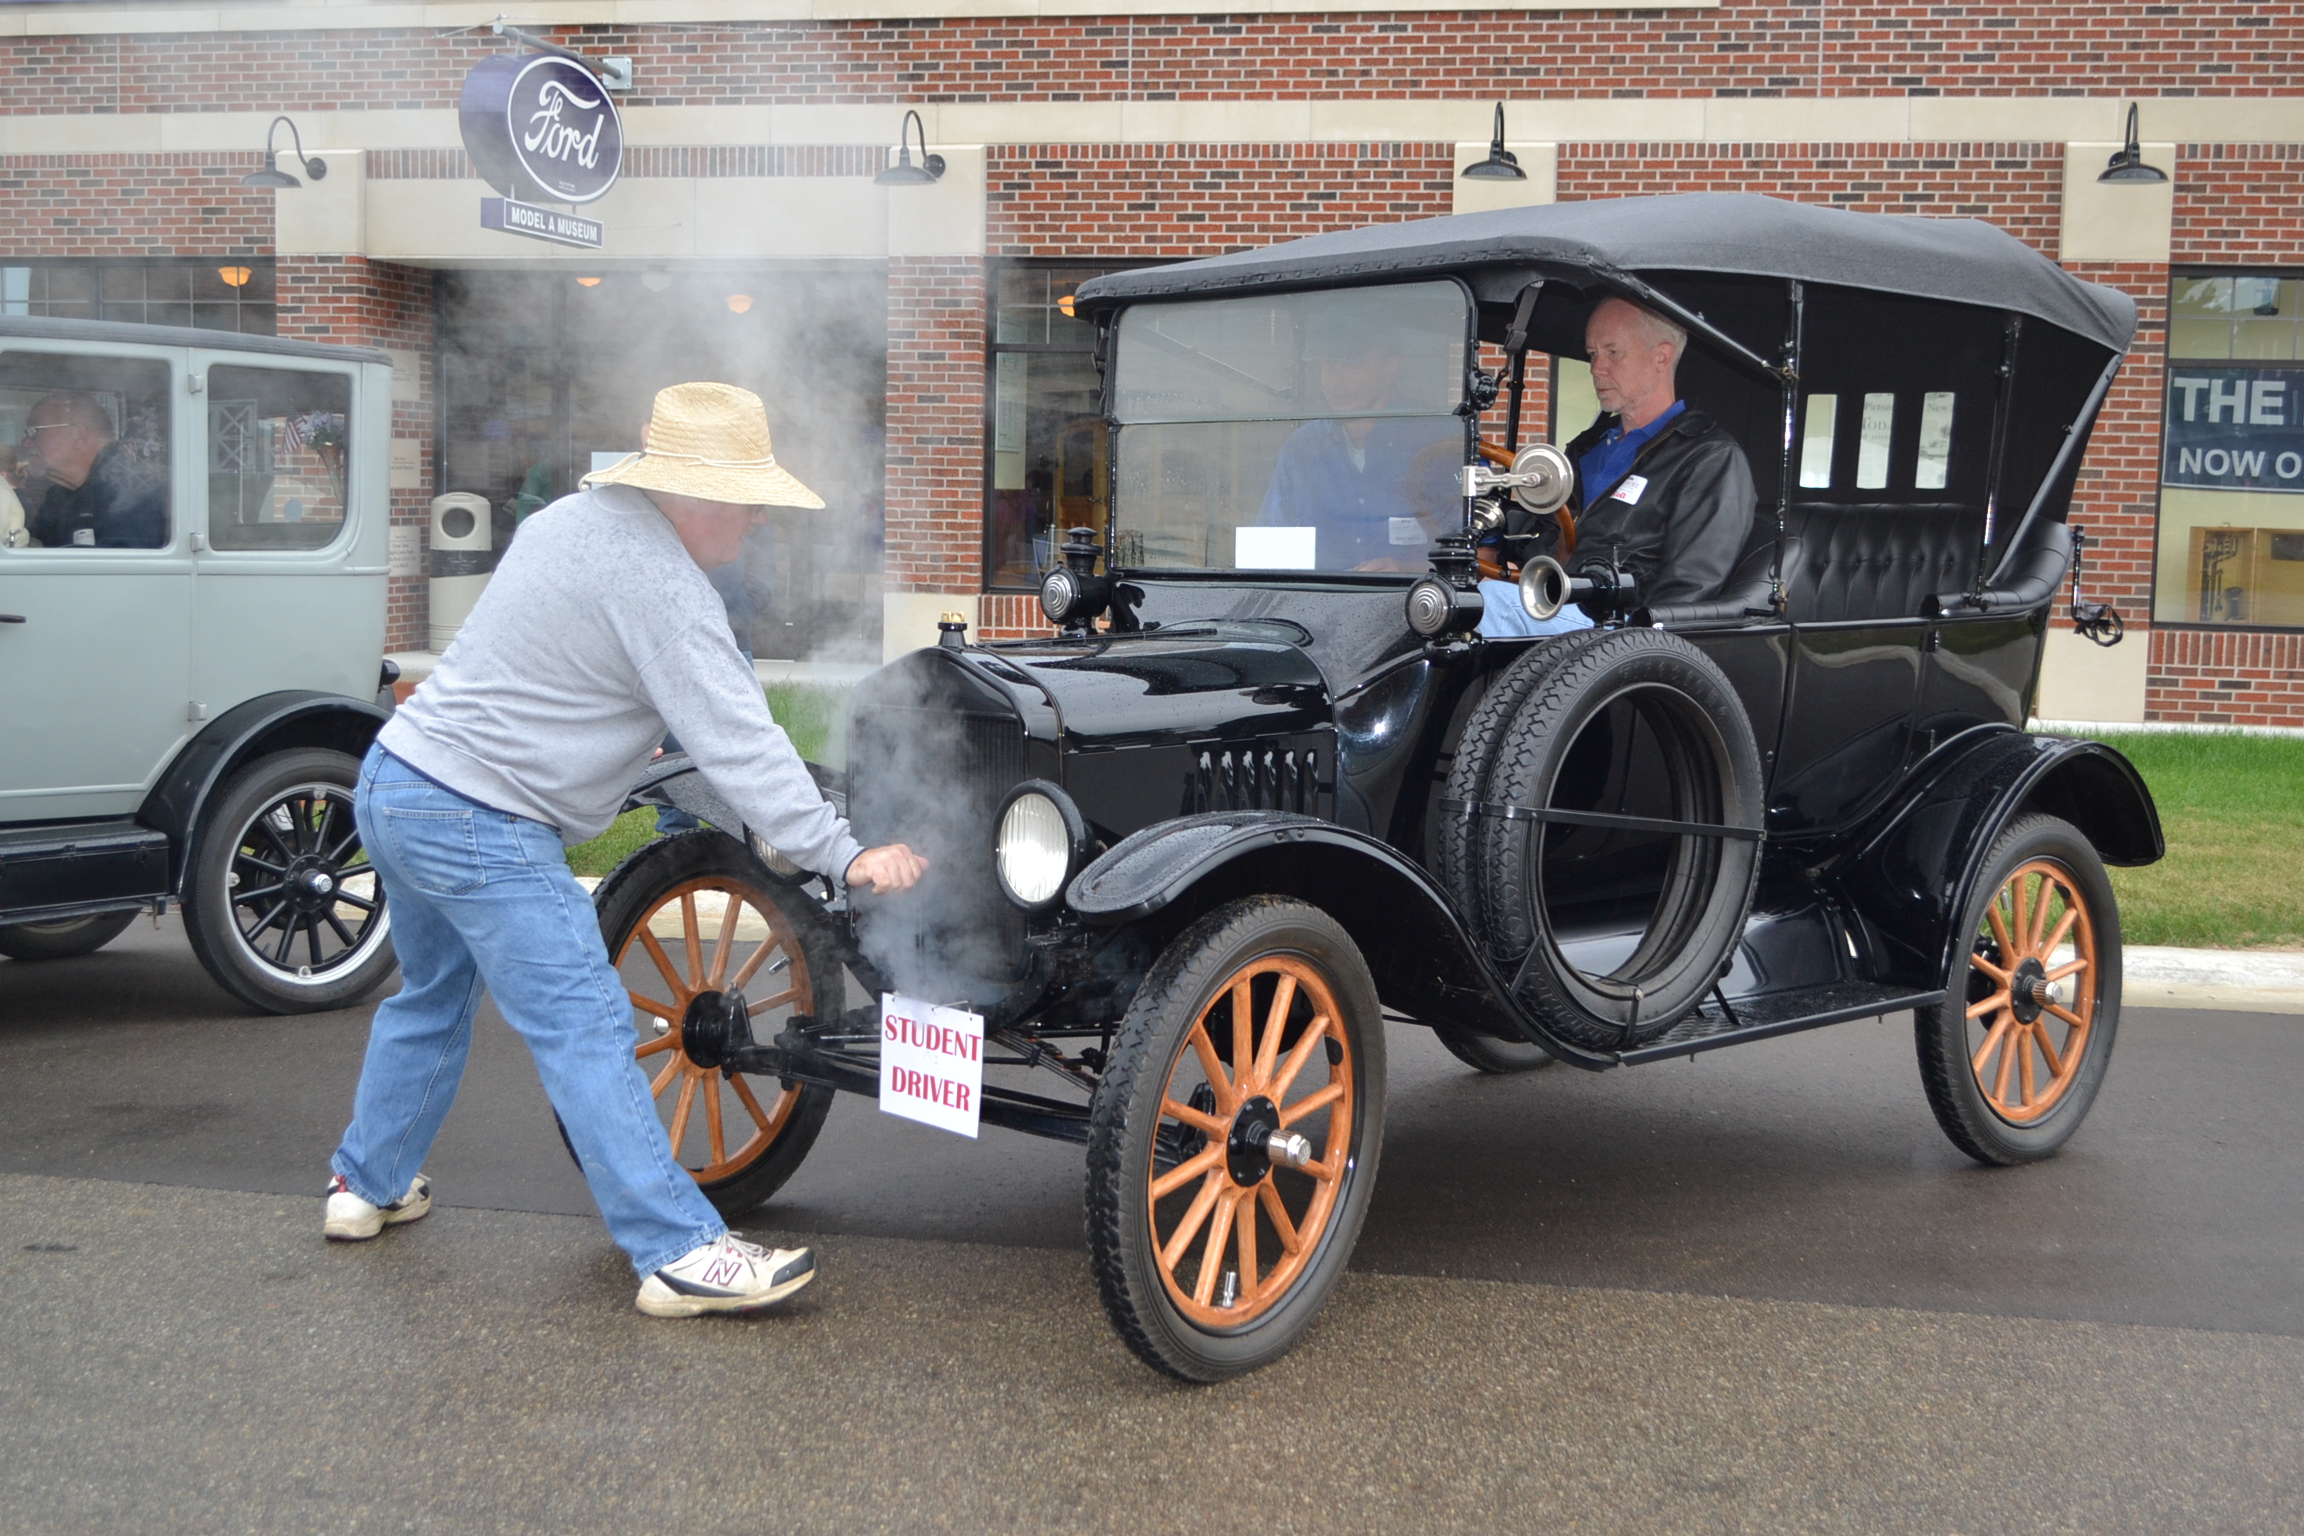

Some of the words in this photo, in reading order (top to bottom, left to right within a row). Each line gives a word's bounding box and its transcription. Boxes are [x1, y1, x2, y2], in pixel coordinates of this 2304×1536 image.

[524, 80, 605, 169] Ford
[511, 206, 546, 230] MODEL
[548, 215, 555, 232] A
[557, 217, 598, 242] MUSEUM
[2173, 377, 2286, 426] THE
[2178, 447, 2267, 477] NOW
[885, 1014, 982, 1062] STUDENT
[892, 1065, 971, 1112] DRIVER
